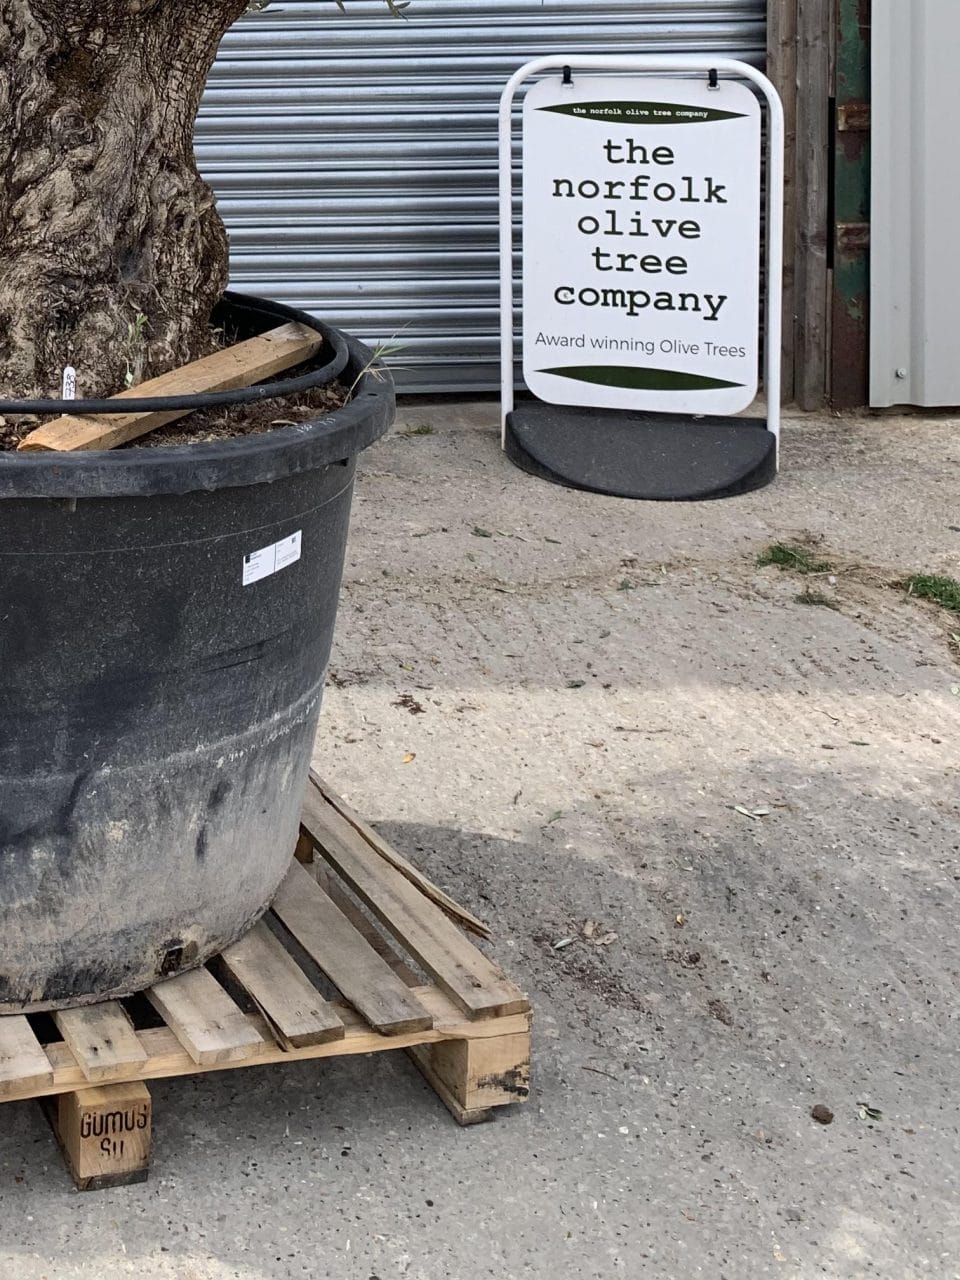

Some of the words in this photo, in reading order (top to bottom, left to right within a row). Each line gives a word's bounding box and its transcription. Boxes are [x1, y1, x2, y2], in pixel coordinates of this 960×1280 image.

[590, 107, 622, 115] norfolk
[676, 110, 708, 119] company
[603, 139, 674, 165] the
[552, 175, 727, 203] norfolk
[578, 210, 700, 239] olive
[592, 247, 687, 275] tree
[554, 287, 727, 321] company
[535, 331, 585, 348] Award
[591, 335, 655, 355] winning
[660, 339, 700, 355] Olive
[704, 342, 746, 358] Trees
